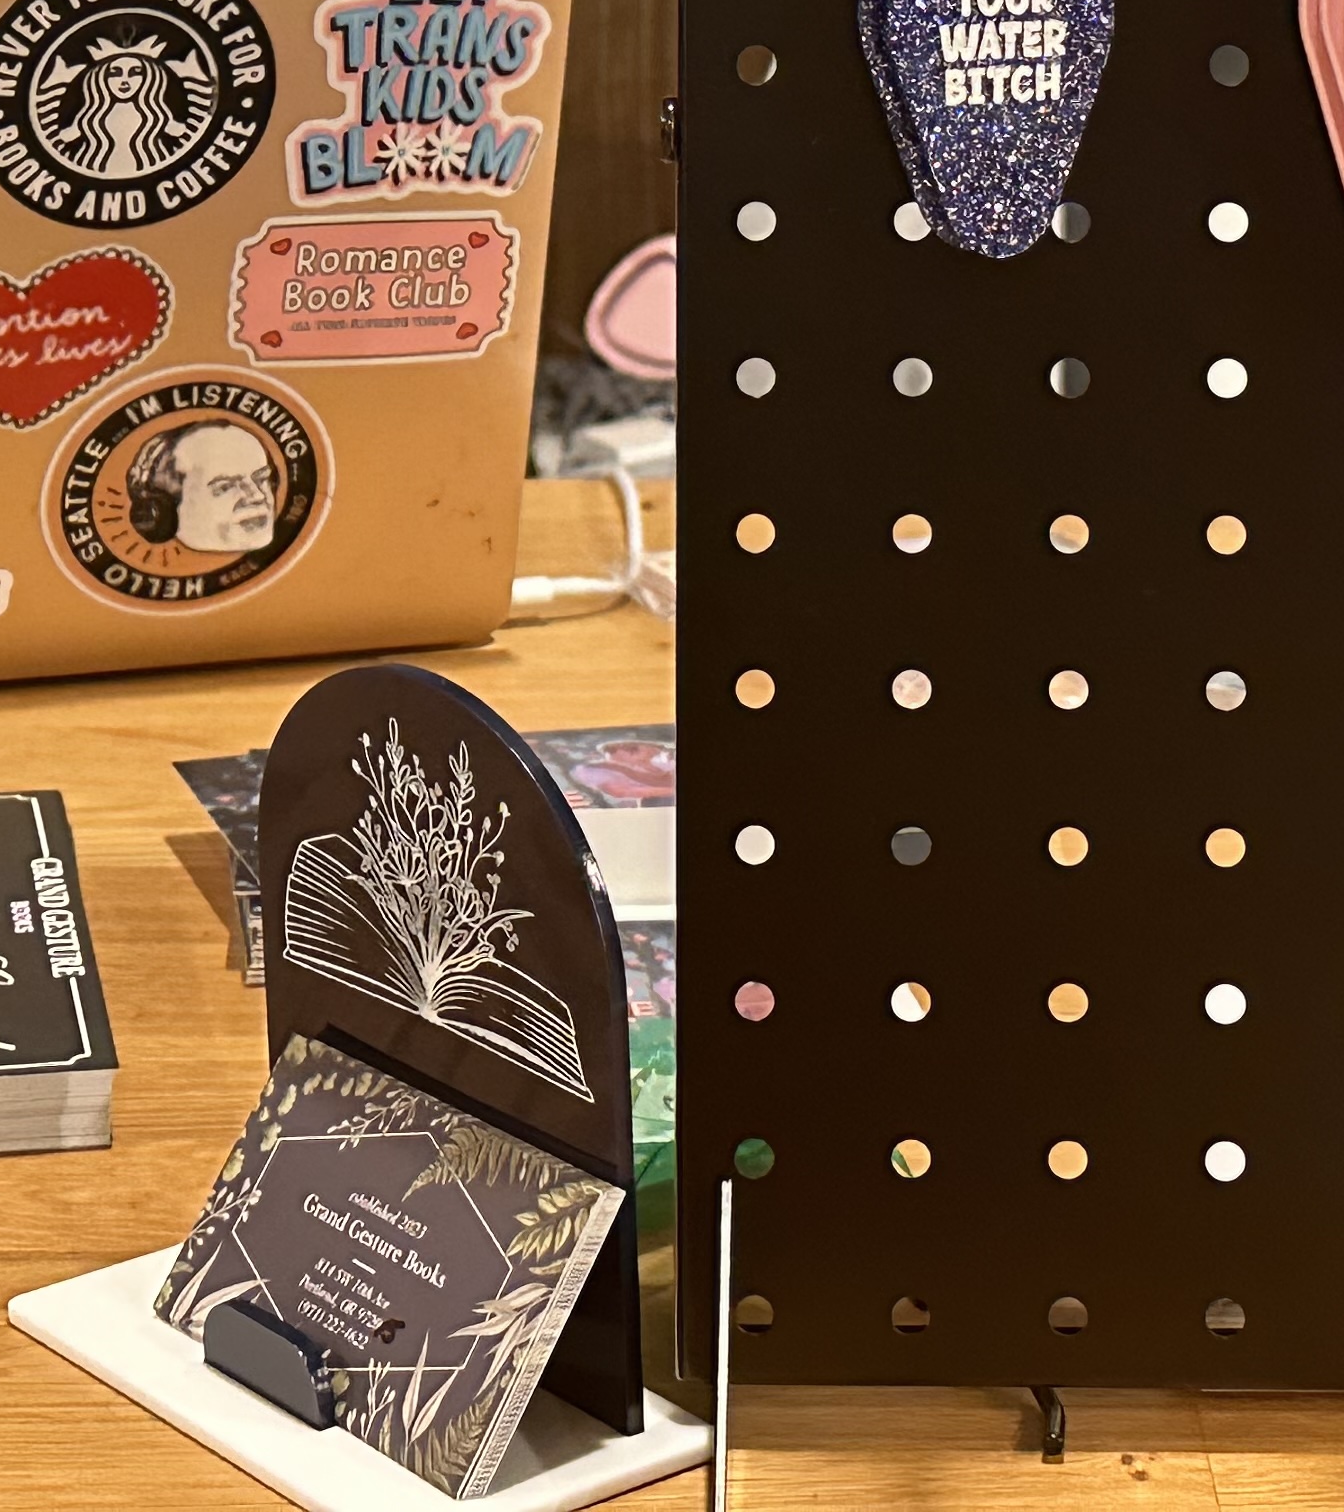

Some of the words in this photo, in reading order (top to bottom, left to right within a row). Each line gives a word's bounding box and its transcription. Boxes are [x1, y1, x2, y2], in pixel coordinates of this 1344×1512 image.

[222, 26, 266, 88] FOR
[331, 4, 534, 76] TRANS
[939, 20, 1067, 62] WATER
[362, 66, 489, 126] KIDS
[945, 63, 1061, 106] BITCH
[74, 190, 146, 221] AND
[156, 115, 256, 210] COFFEE
[296, 243, 467, 275] Romance
[283, 280, 374, 312] Book
[388, 273, 472, 308] Club
[35, 334, 134, 366] lives
[104, 563, 206, 599] HELLO
[173, 385, 307, 459] LISTENING
[31, 857, 70, 908] GRAND
[41, 908, 85, 978] GESTURE
[303, 1193, 351, 1232] Grand
[348, 1219, 403, 1263] Gesture
[402, 1249, 447, 1288] Books
[339, 1299, 358, 1316] OR
